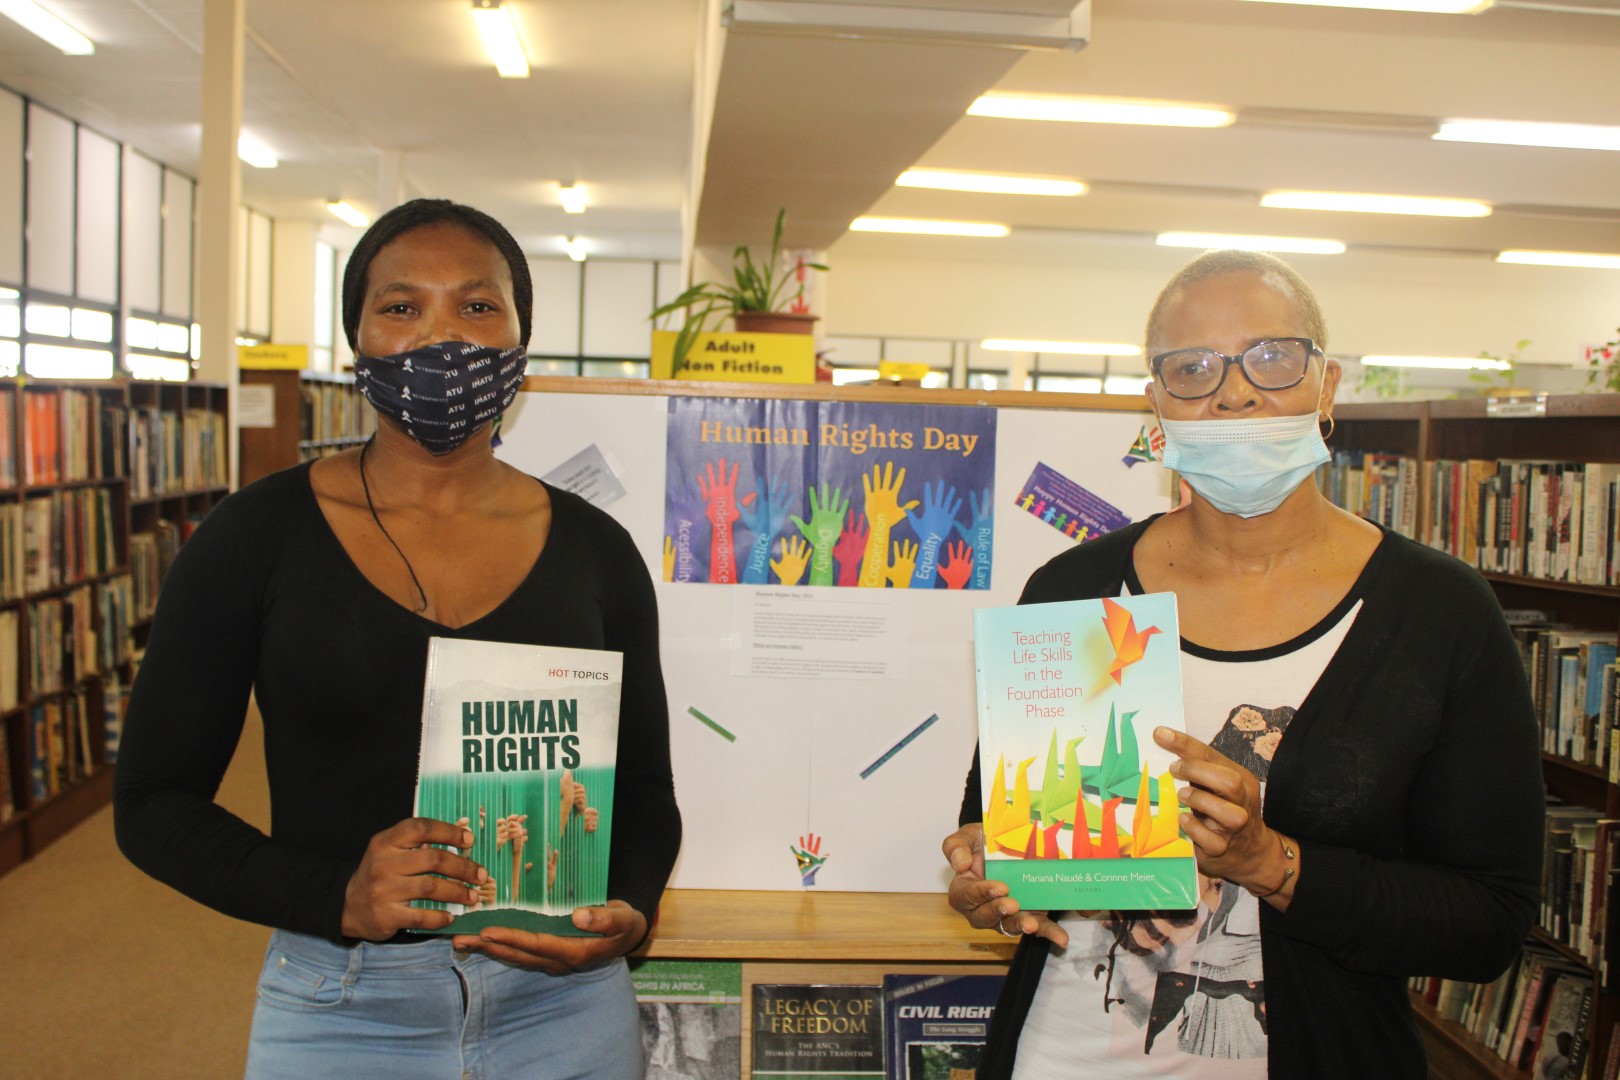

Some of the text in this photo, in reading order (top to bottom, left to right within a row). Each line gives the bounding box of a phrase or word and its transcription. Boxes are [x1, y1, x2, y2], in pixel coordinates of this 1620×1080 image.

[705, 340, 756, 353] Adult
[467, 357, 491, 371] IMATU
[681, 360, 783, 374] Non Fiction
[471, 374, 494, 389] IMATU
[446, 386, 463, 397] ATU
[474, 391, 497, 406] IMATU
[447, 403, 465, 414] ATU
[475, 406, 497, 421] IMATU
[449, 420, 466, 430] ATU
[701, 421, 979, 457] Human Rights Day
[1055, 499, 1079, 516] Human
[1080, 512, 1100, 529] Rights
[749, 533, 770, 573] Justice
[816, 528, 832, 573] Dignity
[864, 513, 887, 586] Cooperation
[916, 532, 942, 580] Equality
[977, 528, 991, 588] Rule of Law
[1012, 629, 1071, 646] Teaching
[1013, 647, 1073, 664] Life Skills
[549, 669, 609, 680] HOT TOPICS
[1024, 666, 1062, 681] in the
[1007, 684, 1083, 701] Foundation
[461, 699, 578, 736] HUMAN
[1025, 704, 1065, 718] Phase
[462, 735, 581, 773] RIGHTS
[1022, 872, 1155, 883] Mariana Naudé & Corinne Meier
[633, 982, 705, 991] GHTS IN AFRICA
[765, 999, 873, 1016] LEGACY OF
[899, 1006, 996, 1018] CIVIL RIGH
[771, 1017, 868, 1034] FREEDOM
